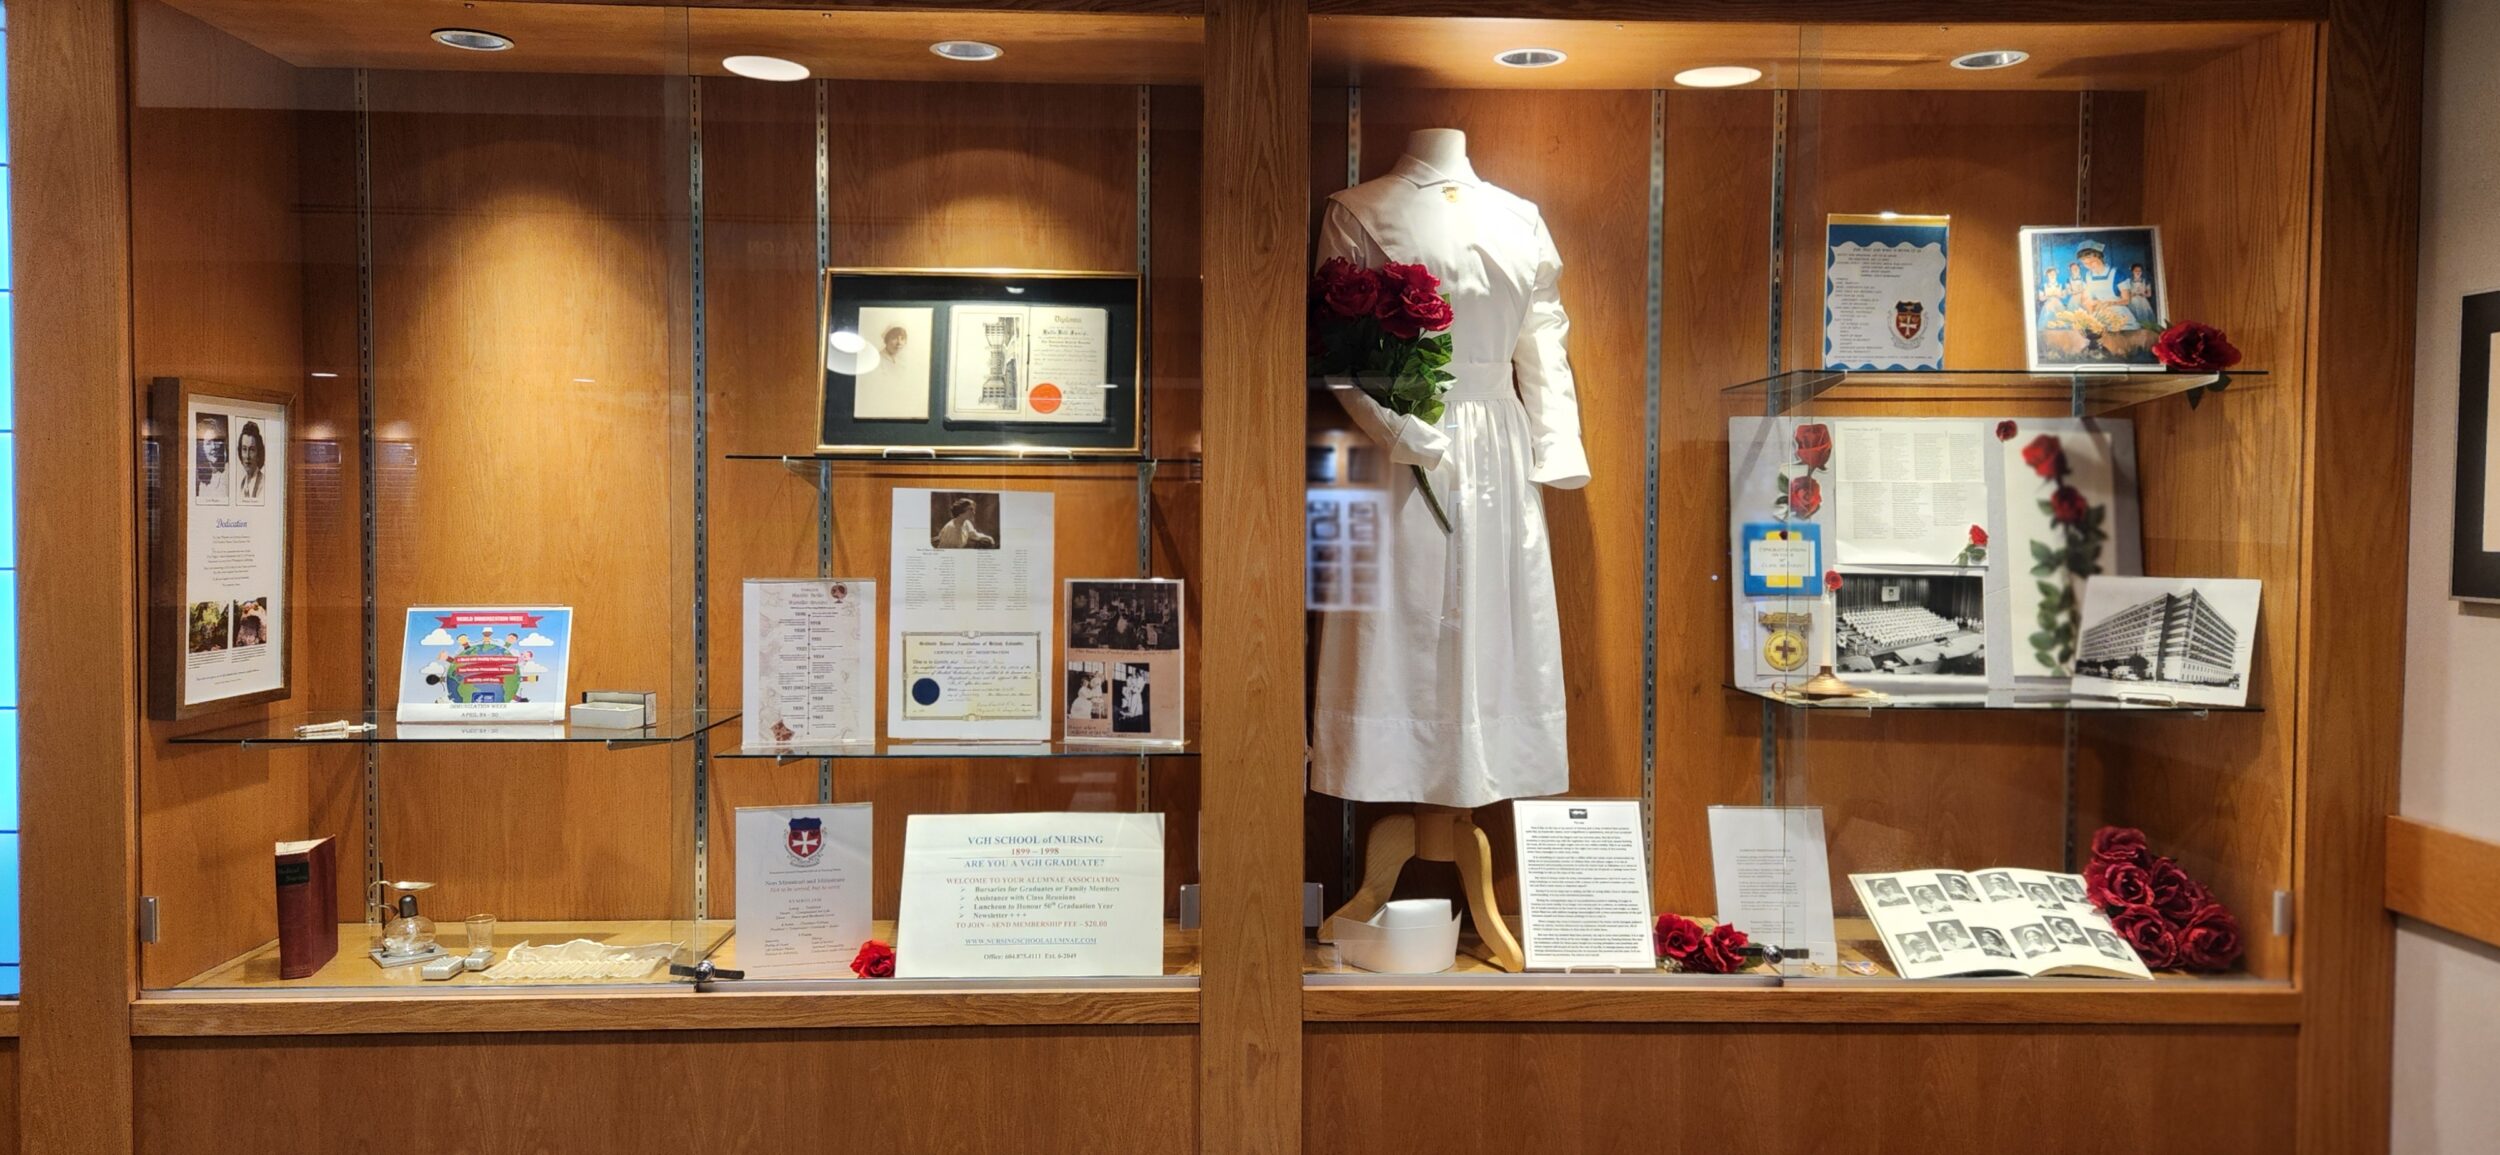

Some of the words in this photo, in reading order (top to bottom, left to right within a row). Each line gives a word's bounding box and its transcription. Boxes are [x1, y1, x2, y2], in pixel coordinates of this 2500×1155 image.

[968, 836, 992, 846] VGH
[994, 836, 1038, 845] SCHOOL
[1042, 835, 1052, 844] of
[1054, 835, 1104, 845] NURSING
[1011, 848, 1030, 856] 1899
[964, 860, 985, 868] ARE
[987, 859, 1008, 868] YOU
[1011, 859, 1018, 867] A
[1020, 859, 1042, 867] VGH
[1045, 858, 1105, 867] GRADUATE?
